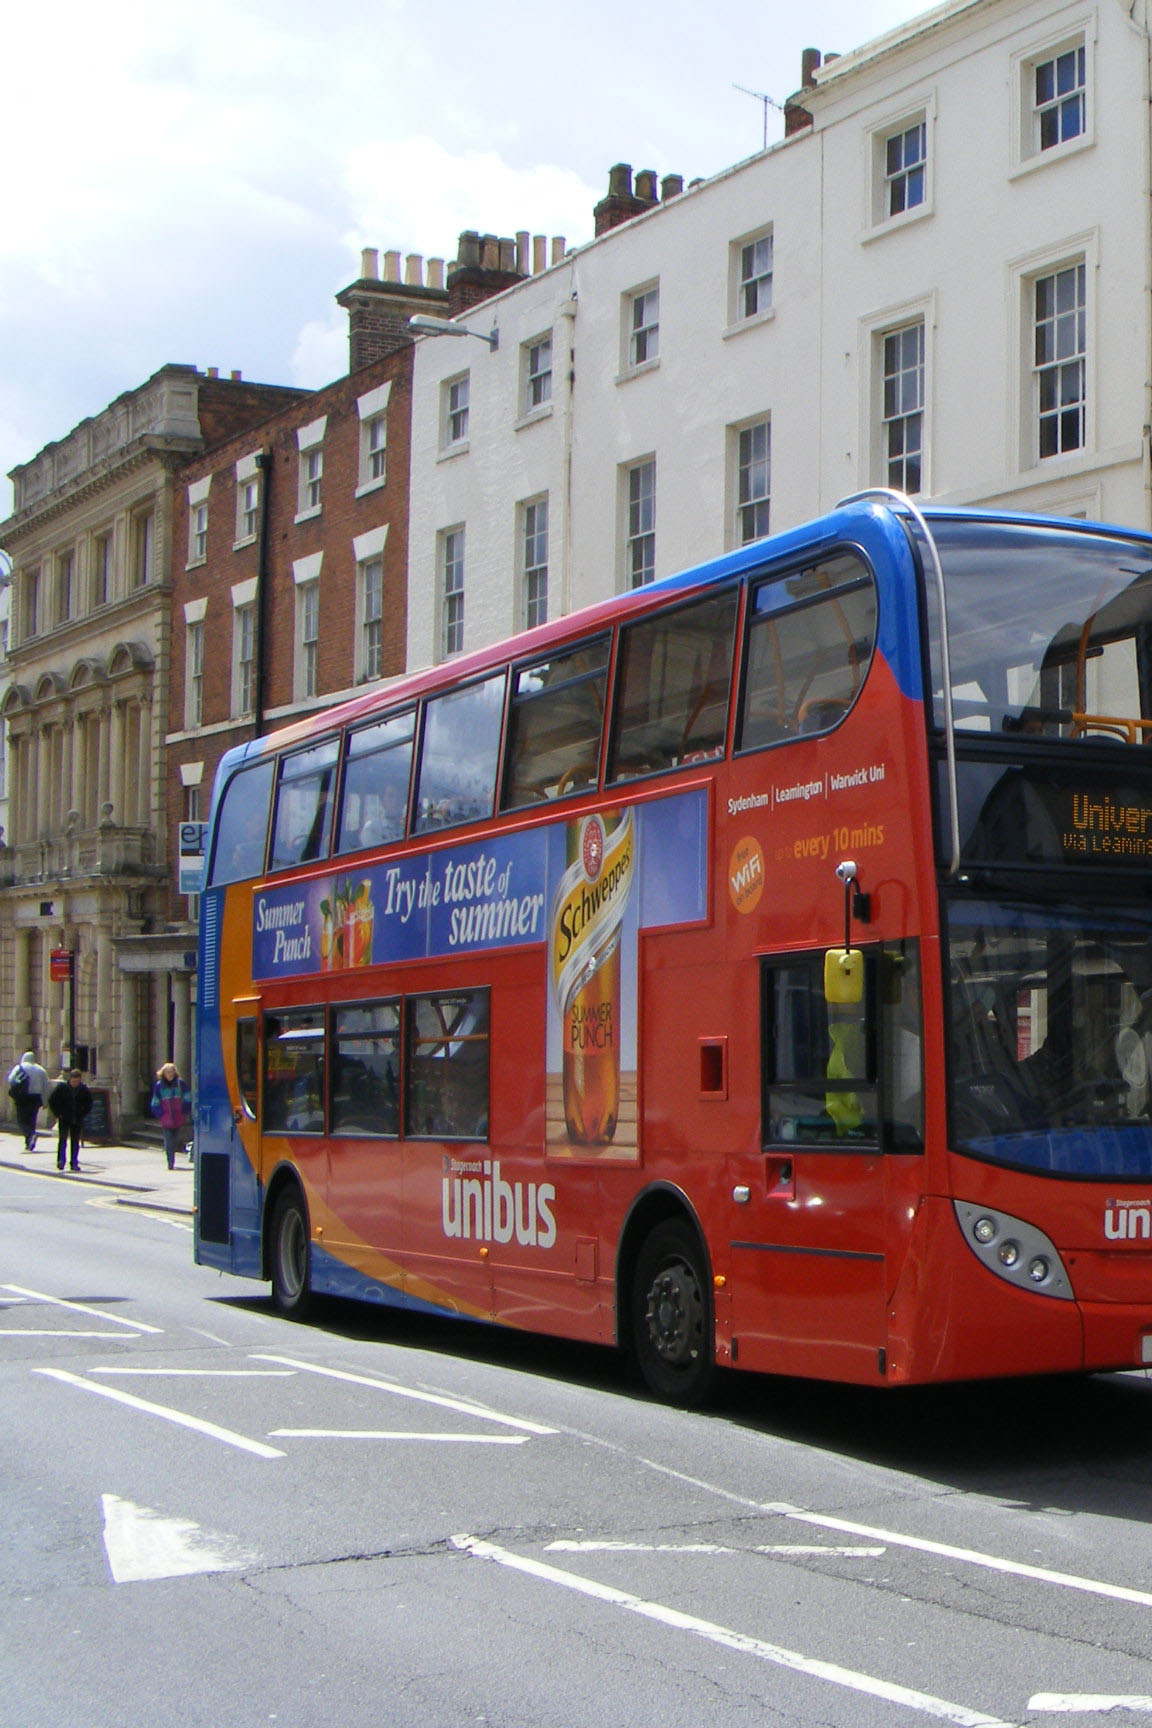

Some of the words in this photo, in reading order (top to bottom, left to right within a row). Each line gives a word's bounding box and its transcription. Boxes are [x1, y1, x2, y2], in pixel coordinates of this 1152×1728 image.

[728, 793, 768, 815] Sydenham
[776, 780, 823, 803] Leamington
[831, 769, 867, 791] Warwick
[869, 763, 885, 782] Uni
[794, 833, 830, 860] every
[833, 827, 849, 851] 10
[851, 823, 885, 849] mins
[1063, 833, 1087, 851] via
[385, 867, 416, 924] Try
[418, 872, 441, 909] the
[444, 854, 497, 904] taste
[498, 861, 513, 898] of
[731, 853, 762, 894] WiFi
[256, 898, 305, 932] Summer
[449, 893, 544, 946] summer
[559, 852, 631, 964] Schweppes
[273, 925, 312, 964] Punch
[571, 1001, 613, 1025] SUMMER
[571, 1024, 613, 1049] PUNCH
[442, 1159, 557, 1248] unibus
